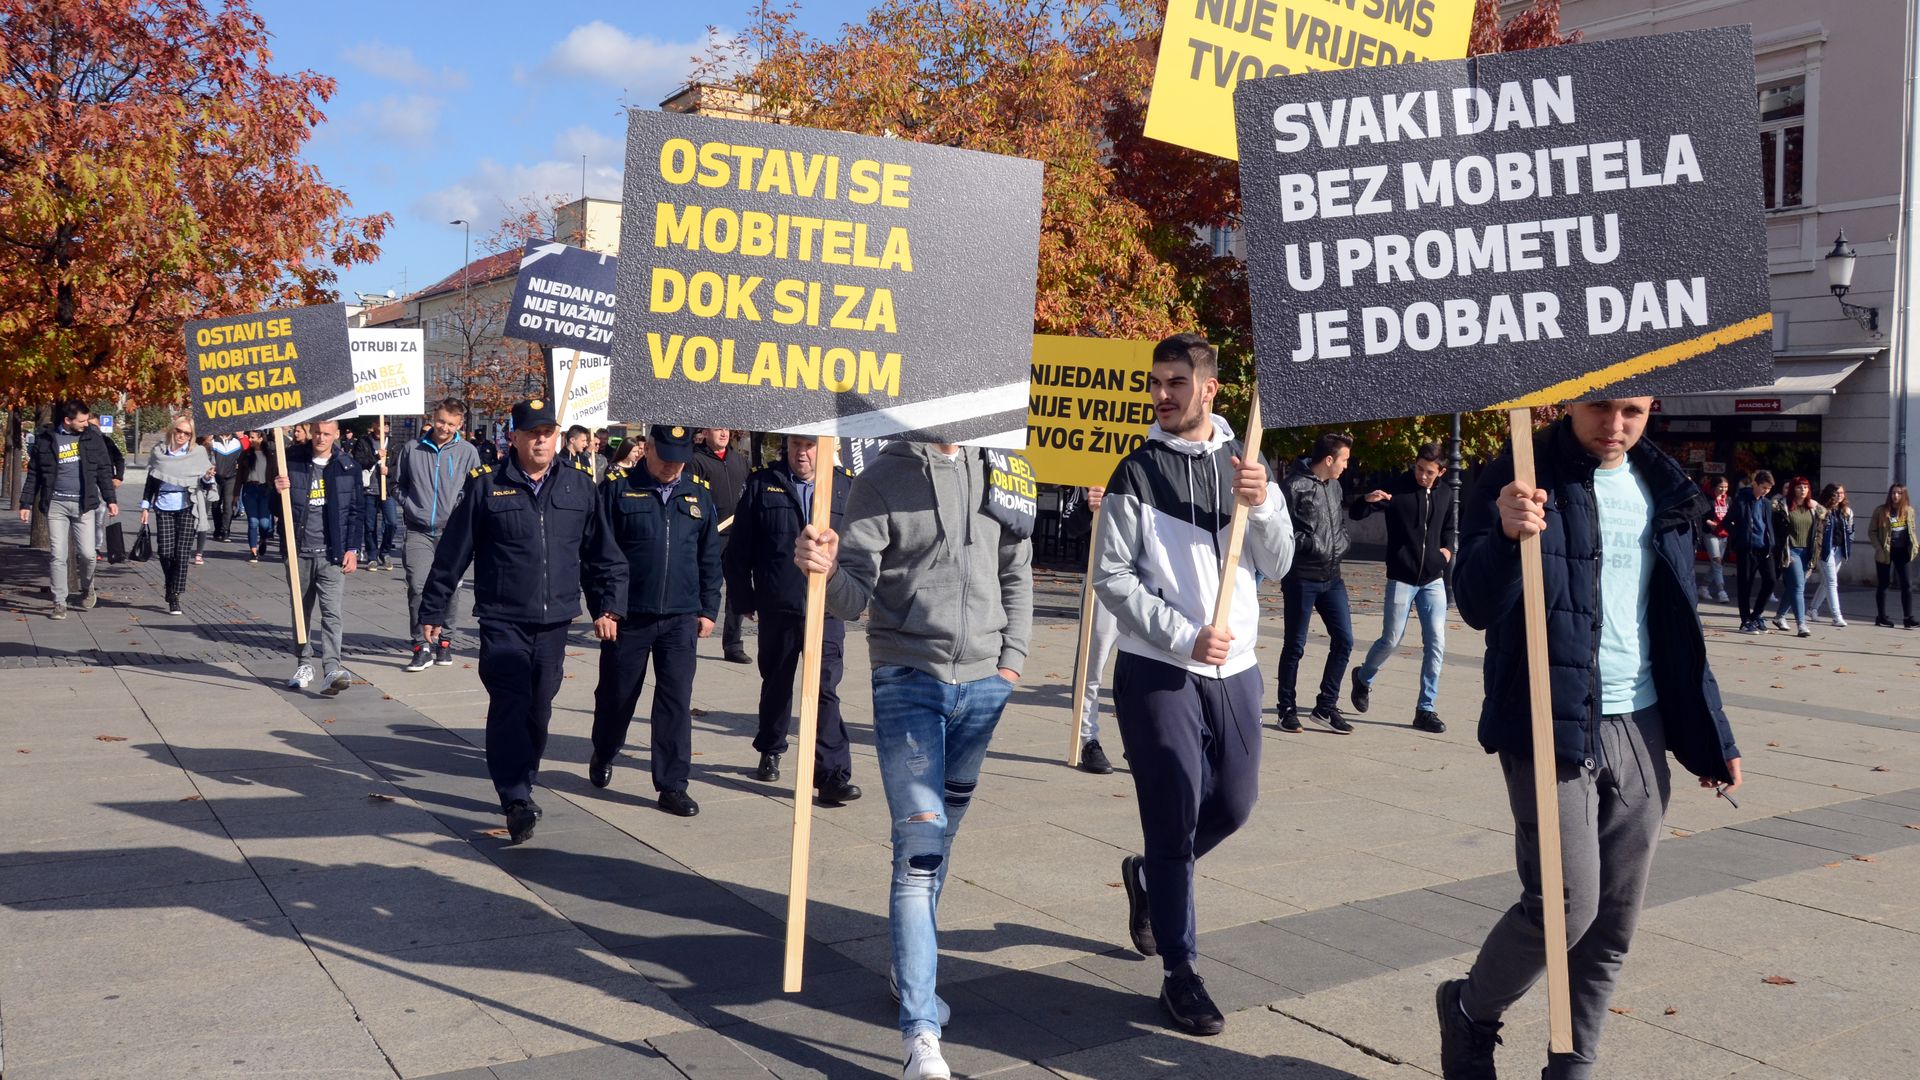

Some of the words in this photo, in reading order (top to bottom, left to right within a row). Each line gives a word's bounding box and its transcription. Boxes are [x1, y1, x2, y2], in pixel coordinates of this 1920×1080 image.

[1195, 0, 1278, 42] NIJE
[1285, 7, 1429, 68] VRIJED
[1272, 89, 1441, 153] SVAKI
[1454, 75, 1575, 136] DAN
[659, 138, 839, 200] OSTAVI
[848, 159, 912, 209] SE
[1279, 165, 1392, 223] BEZ
[1402, 133, 1704, 211] MOBITELA
[654, 203, 914, 273] MOBITELA
[1284, 241, 1325, 292] U
[1337, 213, 1621, 288] PROMETU
[528, 277, 594, 303] NIJEDAN
[594, 291, 616, 308] PO
[649, 267, 765, 322] DOK
[772, 278, 821, 326] SI
[830, 284, 897, 334] ZA
[523, 295, 558, 314] NIJE
[559, 301, 615, 327] VAŽNIJI
[1292, 308, 1351, 363] JE
[1362, 290, 1564, 356] DOBAR
[1586, 276, 1708, 336] DAN
[196, 321, 264, 347] OSTAVI
[266, 318, 292, 338] SE
[519, 313, 542, 329] OD
[545, 318, 586, 338] TVOG
[586, 324, 614, 344] ŽIV
[198, 341, 298, 371] MOBITELA
[351, 341, 397, 352] OTRUBI
[400, 341, 417, 352] ZA
[379, 362, 405, 378] BEZ
[560, 356, 602, 371] PORUBI
[646, 333, 902, 397] VOLANOM
[1030, 363, 1125, 391] NIJEDAN
[201, 373, 244, 396] DOK
[246, 371, 265, 390] SI
[269, 366, 297, 387] ZA
[355, 376, 408, 394] MOBITELA
[356, 397, 363, 406] U
[364, 386, 410, 404] PROMETU
[203, 390, 302, 419] VOLANOM
[579, 400, 608, 418] PROMET
[1028, 394, 1072, 418] NIJE
[1077, 398, 1156, 425] VRIJED
[103, 417, 109, 425] P
[59, 443, 71, 453] AN
[1088, 426, 1148, 455] ŽIVO
[988, 449, 1008, 472] AN
[990, 469, 1038, 499] OBITELA
